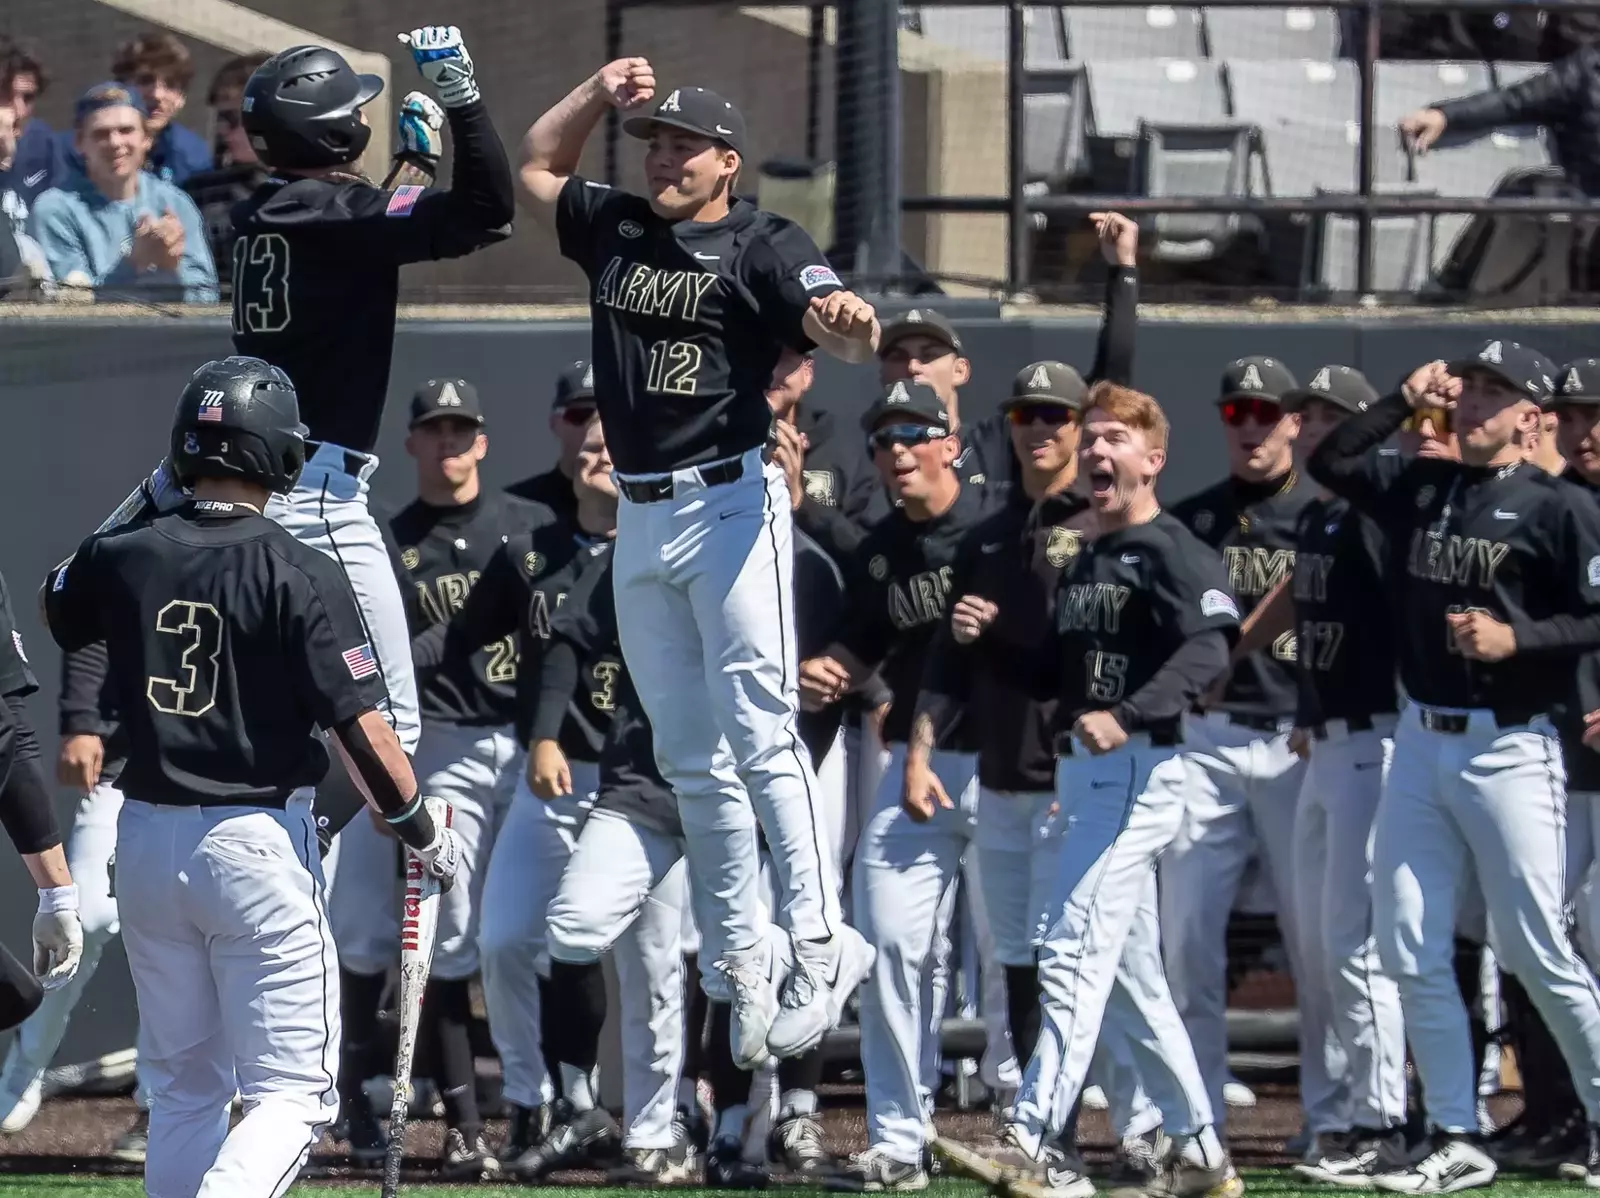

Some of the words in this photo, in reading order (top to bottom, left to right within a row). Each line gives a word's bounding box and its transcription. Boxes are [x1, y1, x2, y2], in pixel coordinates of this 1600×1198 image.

[660, 90, 681, 112] A
[231, 233, 291, 334] 13
[596, 256, 716, 322] ARMY
[1478, 341, 1504, 364] A
[646, 340, 702, 395] 12
[1027, 365, 1052, 390] A
[1239, 364, 1263, 390] A
[1309, 366, 1332, 392] A
[1563, 366, 1585, 393] A
[437, 382, 463, 408] A
[887, 381, 911, 404] A
[221, 441, 229, 453] 3
[212, 501, 234, 511] PRO
[888, 565, 953, 629] AR
[147, 599, 223, 717] 3
[484, 634, 521, 682] 2
[1085, 650, 1128, 702] 15
